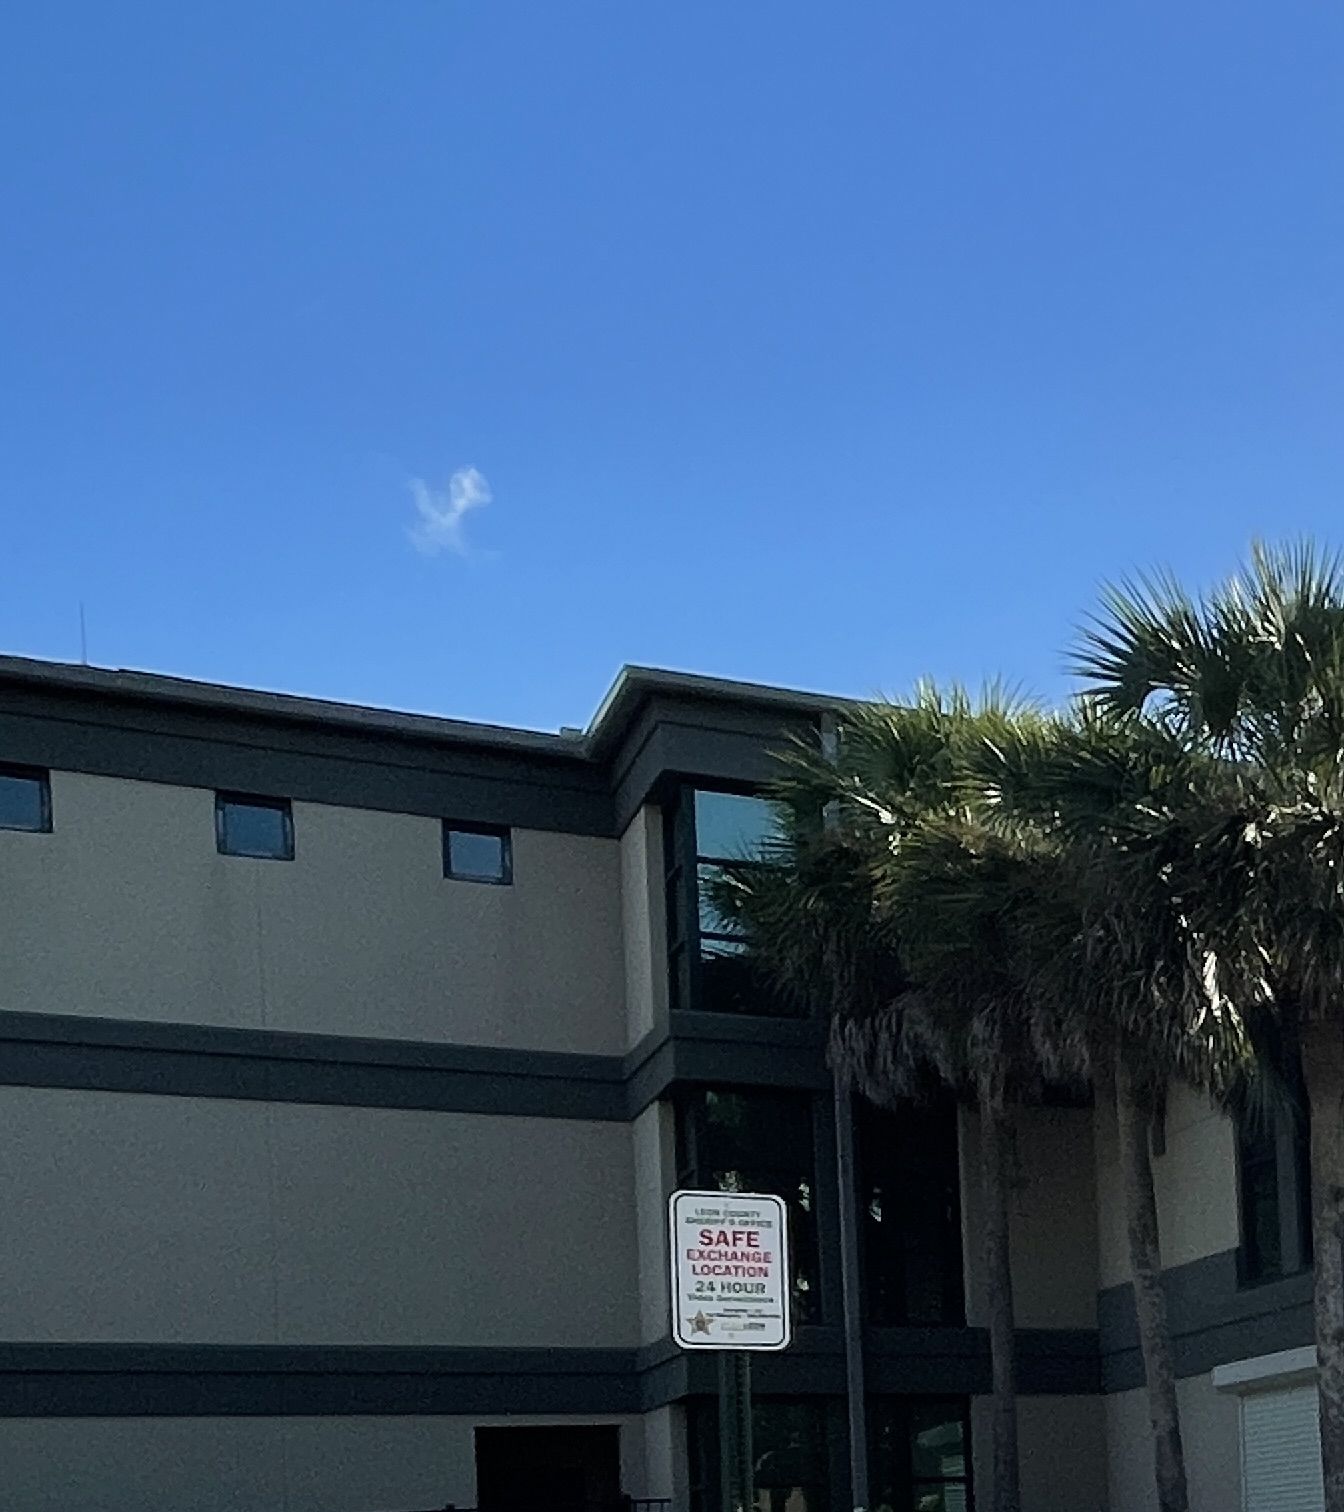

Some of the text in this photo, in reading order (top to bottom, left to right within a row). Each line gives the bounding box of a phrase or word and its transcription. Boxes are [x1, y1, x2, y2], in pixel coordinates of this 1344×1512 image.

[699, 1229, 760, 1247] SAFE
[687, 1249, 772, 1263] EXCHANGE
[692, 1265, 768, 1277] LOCATION
[695, 1281, 765, 1293] 24 HOUR
